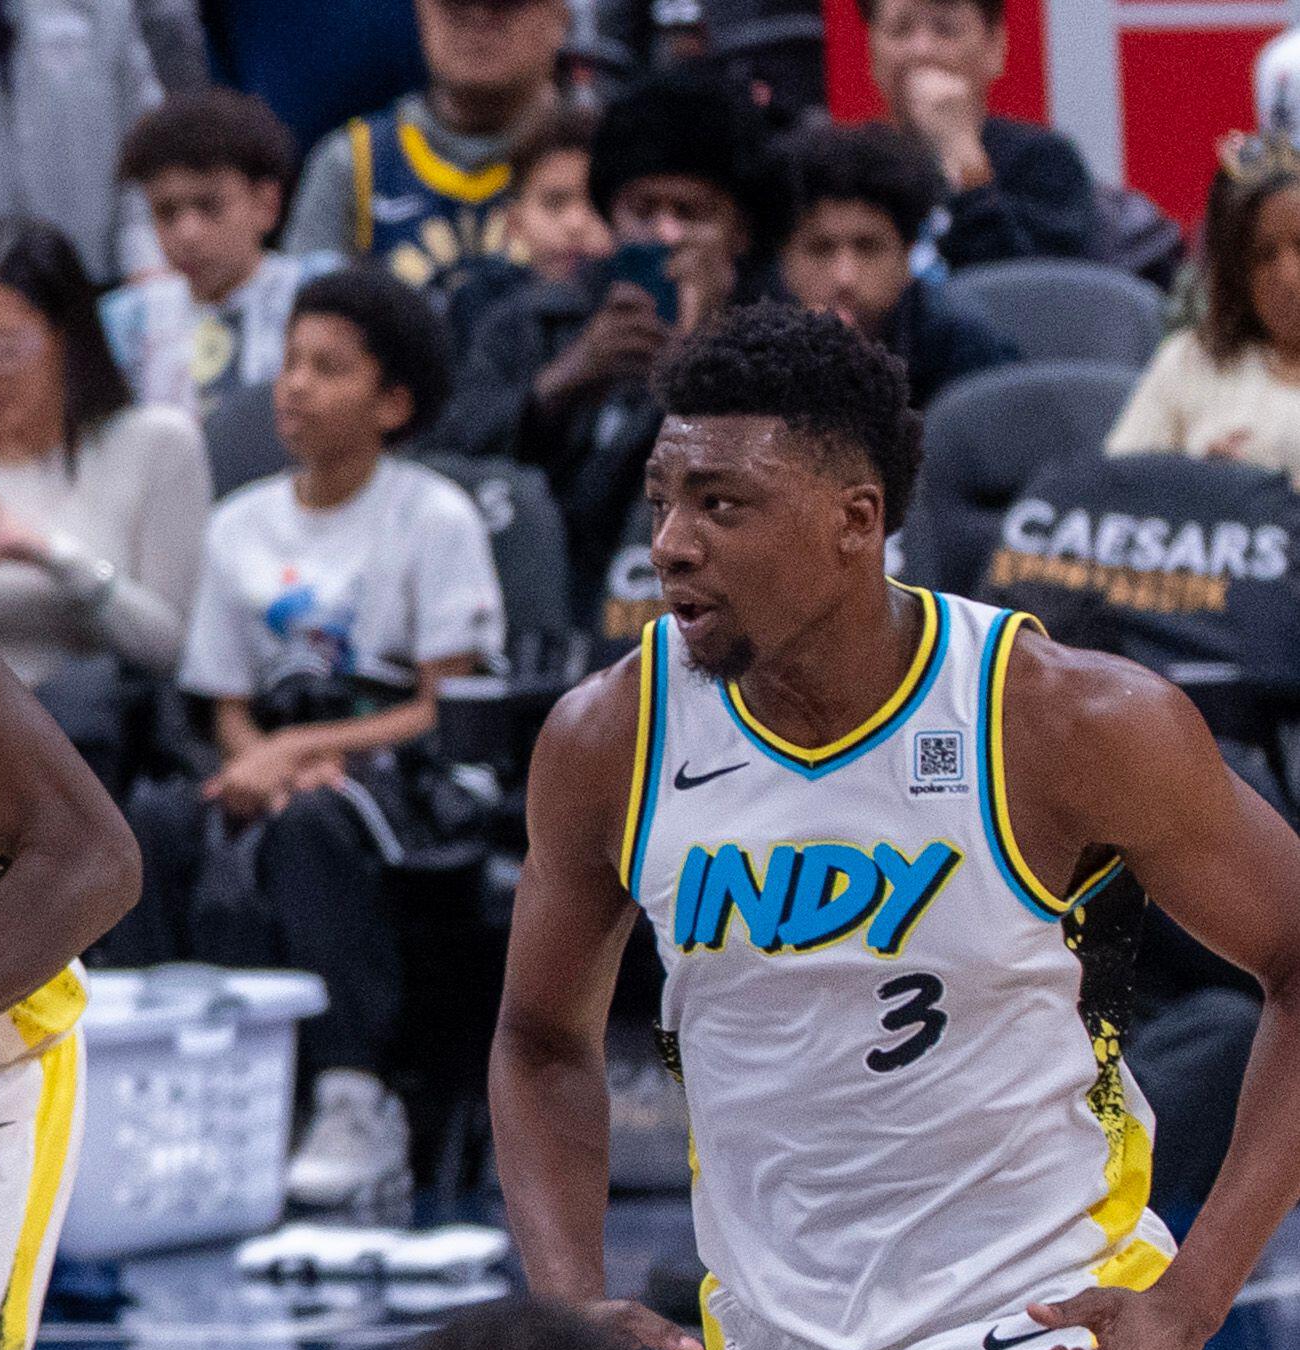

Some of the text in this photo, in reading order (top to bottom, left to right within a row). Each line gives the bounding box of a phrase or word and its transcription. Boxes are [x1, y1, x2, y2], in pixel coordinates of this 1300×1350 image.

[1001, 498, 1289, 579] CAESARS
[908, 782, 969, 797] spokenote
[672, 838, 966, 959] INDY
[865, 972, 949, 1073] 3
